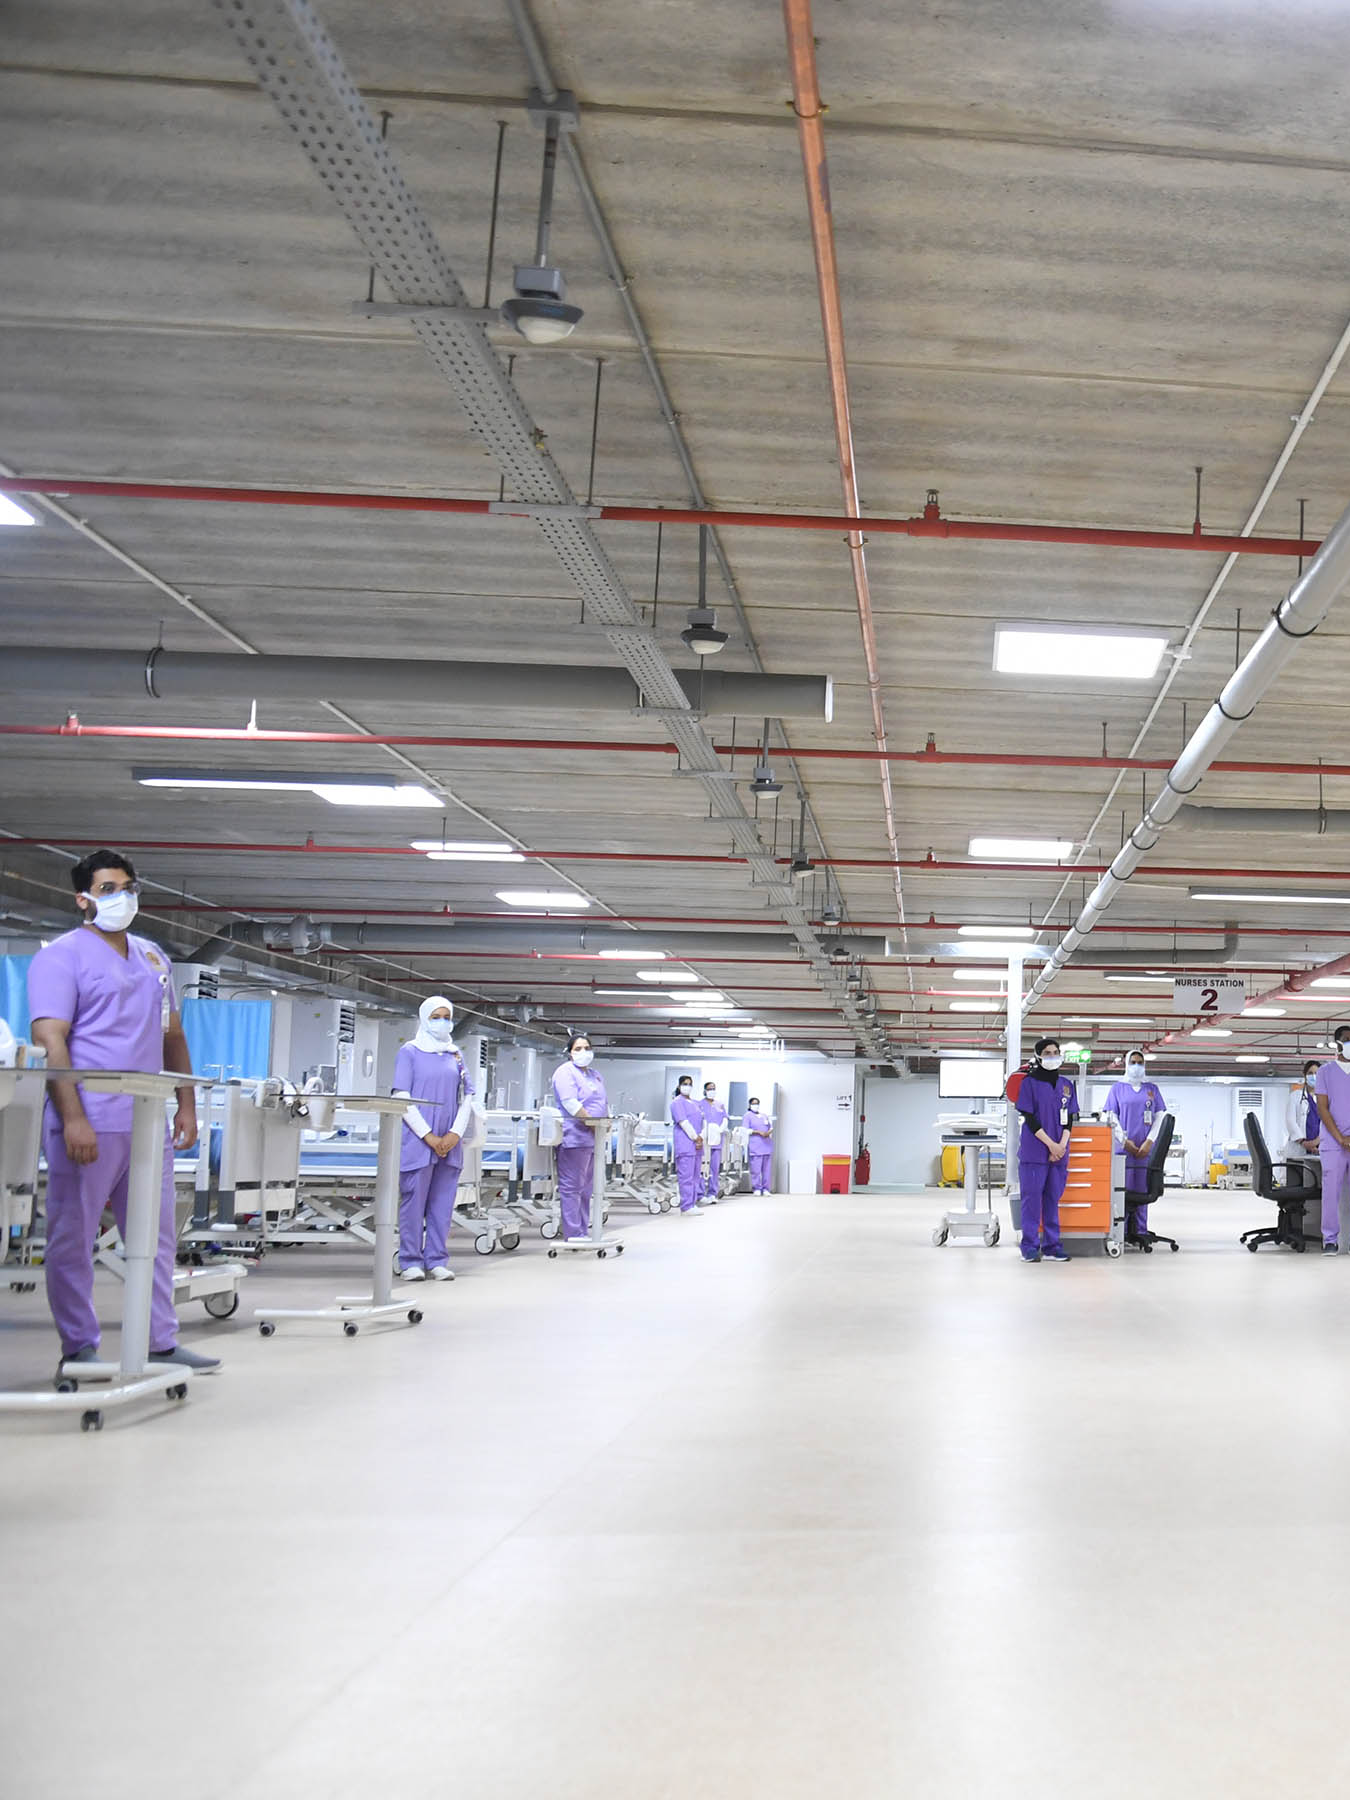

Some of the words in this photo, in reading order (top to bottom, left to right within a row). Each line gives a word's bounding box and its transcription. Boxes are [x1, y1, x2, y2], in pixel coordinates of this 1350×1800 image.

[1175, 979, 1208, 987] NURSES
[1210, 979, 1244, 987] STATION
[1200, 988, 1218, 1011] 2
